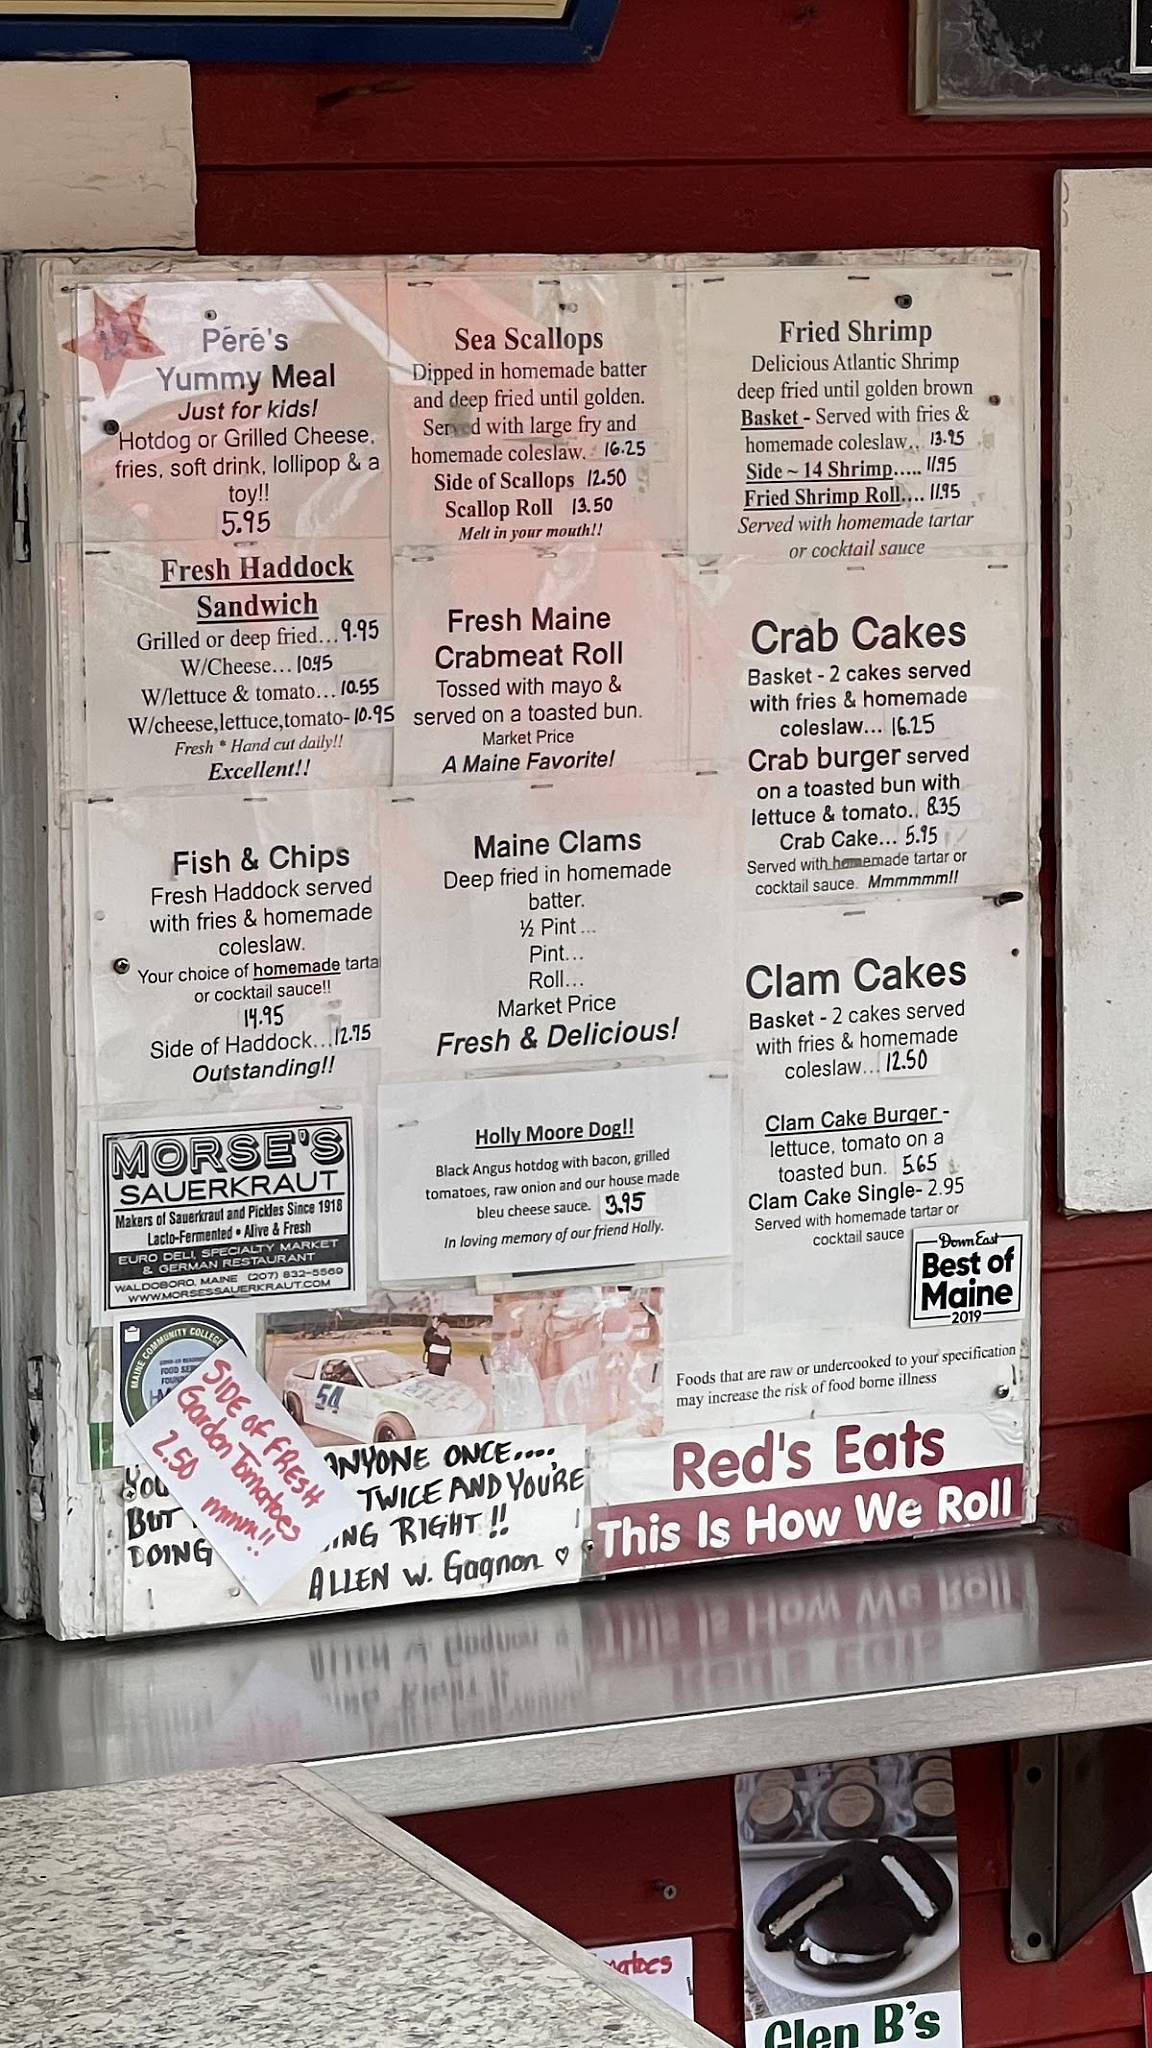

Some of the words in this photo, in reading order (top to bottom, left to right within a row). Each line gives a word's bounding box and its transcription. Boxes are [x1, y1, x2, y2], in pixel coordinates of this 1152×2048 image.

[454, 328, 496, 350] Sea
[504, 327, 603, 354] Scallops
[779, 320, 839, 343] Fried
[848, 320, 932, 347] Shrimp
[156, 366, 262, 395] Yummy
[272, 363, 335, 388] Meal
[178, 402, 224, 421] Just
[231, 401, 262, 420] for
[267, 399, 319, 418] kids!
[434, 473, 472, 491] Side
[478, 472, 496, 489] of
[501, 471, 574, 492] Scallops
[587, 468, 626, 488] 12.50
[229, 483, 270, 506] toy!!
[744, 489, 789, 508] Fried
[796, 488, 859, 506] Shrimp
[930, 483, 960, 500] 11.95
[445, 500, 510, 521] Scallop
[516, 499, 552, 516] Roll
[572, 497, 613, 516] 13.50
[221, 510, 270, 537] 5.95
[458, 526, 490, 541] Melt
[494, 526, 507, 540] in
[510, 528, 542, 542] your
[546, 524, 602, 538] mouth!!
[160, 558, 230, 582] Fresh
[240, 554, 354, 580] Haddock
[197, 592, 318, 619] Sandwich
[448, 608, 521, 632] Fresh
[532, 607, 610, 631] Maine
[751, 618, 838, 654] Crab
[852, 614, 967, 650] Cakes
[298, 655, 332, 673] 10.45
[436, 644, 563, 669] Crabmeat
[573, 641, 623, 665] Roll
[354, 705, 395, 725] 10.95
[780, 719, 882, 737] coleslaw...
[892, 714, 935, 736] 16.25
[482, 731, 531, 746] Market
[536, 730, 574, 744] Price
[208, 759, 310, 781] Excellent!!
[442, 756, 456, 774] A
[463, 754, 520, 772] Maine
[527, 750, 615, 770] Favorite!
[749, 748, 807, 772] Crab
[818, 748, 900, 772] burger
[907, 746, 969, 764] served
[474, 834, 549, 859] Maine
[559, 830, 641, 854] Clams
[780, 832, 824, 850] Crab
[832, 830, 896, 848] Cake...
[906, 826, 938, 845] 5.95
[174, 849, 230, 875] Fish
[241, 847, 258, 871] &
[270, 844, 350, 872] Chips
[755, 879, 808, 895] cocktail
[219, 935, 305, 956] coleslaw.
[746, 964, 839, 999] Clam
[854, 955, 967, 992] Cakes
[244, 1004, 284, 1029] 14.95
[150, 1041, 193, 1059] Side
[201, 1037, 220, 1056] of
[335, 1024, 371, 1045] 12.75
[437, 1029, 510, 1056] Fresh
[520, 1026, 538, 1050] &
[547, 1016, 680, 1048] Delicious!
[193, 1056, 335, 1082] Outstanding!!
[886, 1049, 927, 1072] 12.50
[476, 1128, 520, 1146] Holly
[526, 1124, 583, 1142] Moore
[589, 1118, 634, 1138] Dog!!
[111, 1128, 345, 1180] MORSE'S
[779, 1161, 844, 1183] toasted
[850, 1159, 887, 1177] bun.
[120, 1170, 338, 1205] SAUERKRAUT
[748, 1192, 797, 1210] Clam
[804, 1189, 851, 1206] Cake
[857, 1181, 922, 1203] Single-
[928, 1176, 964, 1196] 2.95
[115, 1210, 153, 1228] Makers
[156, 1211, 167, 1225] of
[170, 1206, 223, 1225] Sauerkraut
[227, 1206, 245, 1220] and
[249, 1203, 284, 1218] Pickles
[288, 1200, 315, 1215] Since
[319, 1199, 342, 1212] 1918
[477, 1206, 504, 1220] bleu
[508, 1203, 550, 1217] cheese
[554, 1201, 591, 1214] sauce.
[606, 1192, 646, 1216] 3.95
[148, 1226, 233, 1246] Lacto-Fermented
[244, 1224, 269, 1238] Alive
[273, 1223, 279, 1235] &
[283, 1220, 312, 1235] Fresh
[922, 1252, 981, 1279] Best
[988, 1246, 1014, 1273] of
[922, 1278, 1013, 1311] Maine
[952, 1310, 981, 1324] 2019
[131, 1359, 145, 1388] MAINE
[142, 1329, 187, 1359] COMMUNITY
[203, 1358, 250, 1418] SIDE
[676, 1394, 704, 1409] may
[708, 1387, 759, 1405] increase
[763, 1386, 781, 1398] the
[785, 1383, 807, 1397] risk
[812, 1381, 824, 1394] of
[828, 1378, 855, 1393] food
[860, 1375, 895, 1389] borne
[899, 1371, 937, 1386] illness
[153, 1429, 199, 1480] 2.50
[672, 1429, 811, 1492] Red's
[836, 1419, 945, 1475] Eats
[357, 1479, 443, 1512] TWICE
[449, 1473, 501, 1502] AND
[390, 1510, 483, 1545] RIGHT
[489, 1503, 509, 1539] !!
[597, 1511, 680, 1560] This
[698, 1510, 731, 1549] Is
[746, 1503, 842, 1545] How
[854, 1490, 922, 1534] We
[938, 1476, 1012, 1526] Roll
[129, 1539, 212, 1567] DOING
[309, 1562, 389, 1601] ALLEN
[444, 1549, 544, 1584] Gagnon
[875, 2001, 940, 2044] B's
